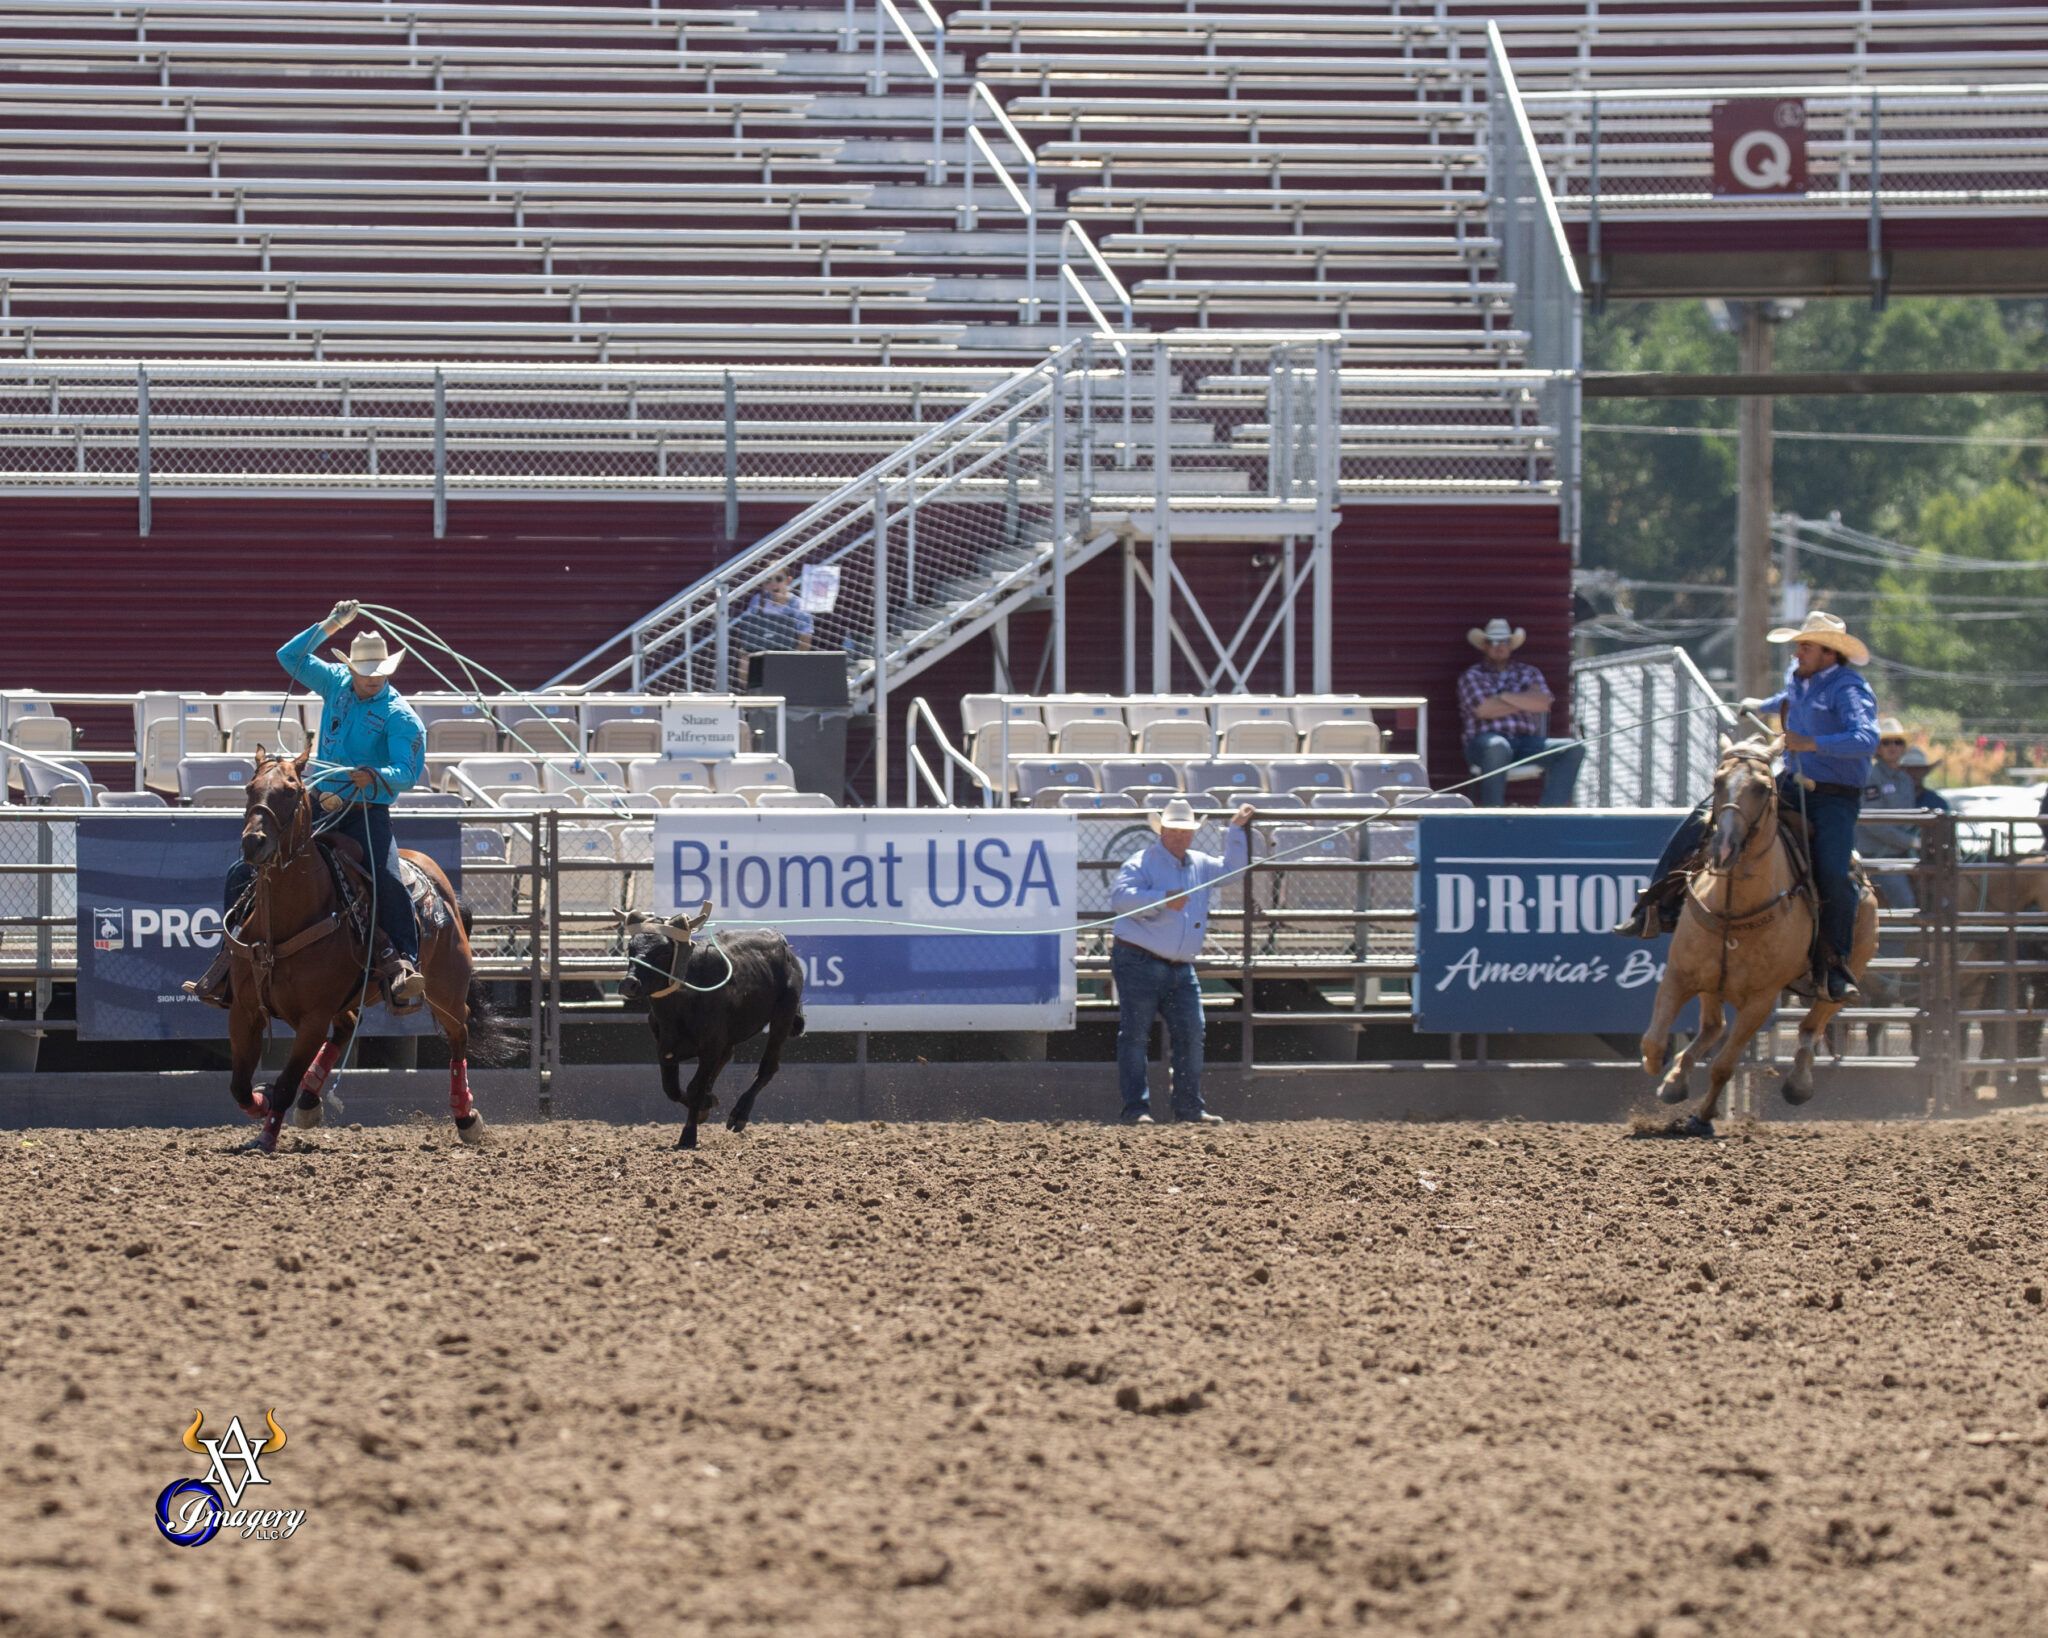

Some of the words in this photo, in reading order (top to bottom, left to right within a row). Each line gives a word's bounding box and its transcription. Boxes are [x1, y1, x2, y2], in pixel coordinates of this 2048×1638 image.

[1730, 130, 1792, 189] Q
[667, 730, 735, 745] Palfreyman
[681, 709, 719, 725] Shane
[672, 840, 903, 909] Biomat
[927, 838, 1060, 908] USA
[132, 907, 222, 948] PRC
[1435, 946, 1610, 991] America's
[157, 994, 175, 1003] SIGN
[175, 994, 186, 1002] UP
